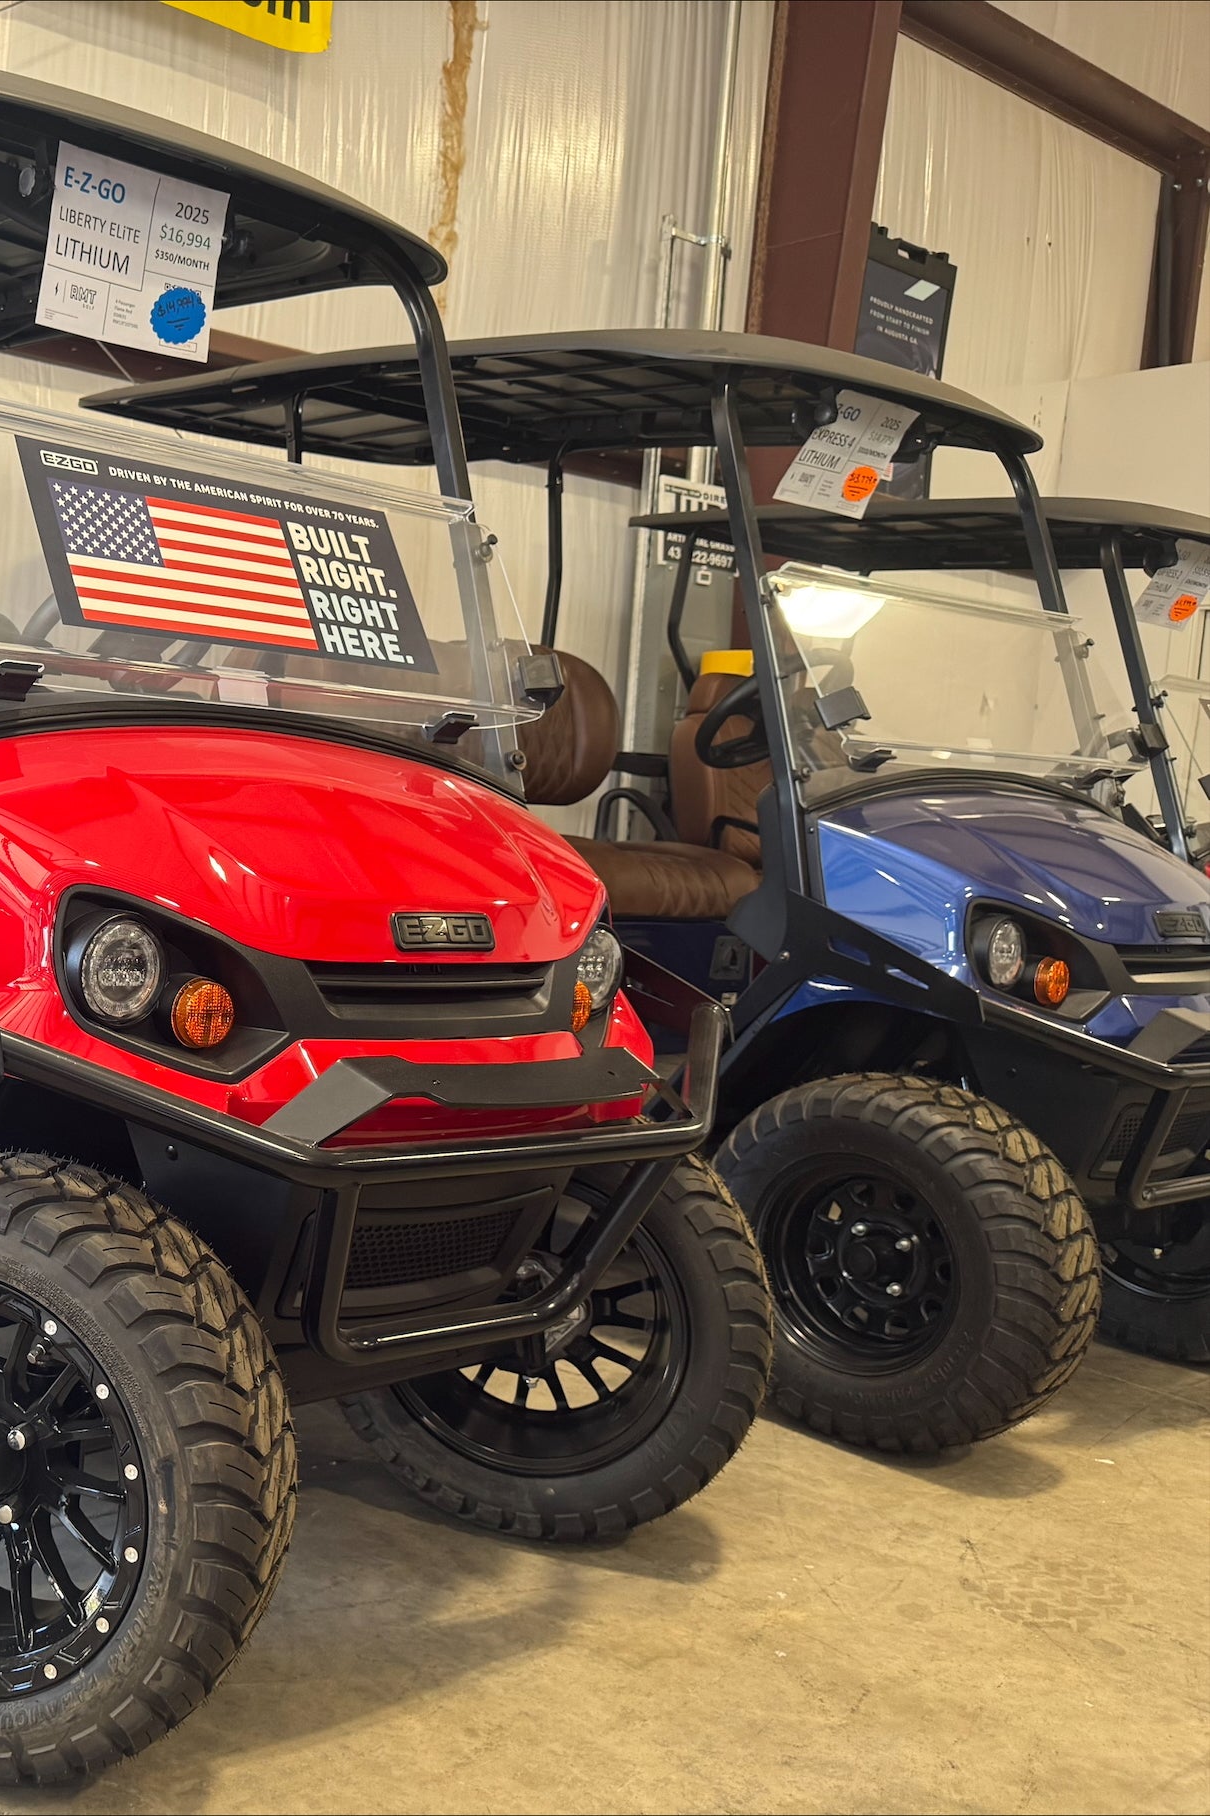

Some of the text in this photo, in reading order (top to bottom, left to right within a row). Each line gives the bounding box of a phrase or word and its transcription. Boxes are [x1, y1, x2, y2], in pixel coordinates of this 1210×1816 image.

[64, 166, 126, 204] E-Z-GO
[59, 206, 107, 233] LIBERTY
[175, 202, 210, 225] 2025
[159, 224, 211, 250] $16,994
[55, 234, 130, 275] LITHIUM
[155, 249, 210, 271] $350/MONTH
[870, 308, 930, 336] FROM START TO FINISH
[884, 328, 908, 342] AUGUSTA
[838, 403, 861, 421] Z-GO
[880, 416, 901, 431] 2025
[798, 448, 841, 469] LITHIUM
[42, 451, 379, 529] EZGO DRIVEN BY THE AMERICAN SPIRIT FOR OVER 70 YEARS.
[286, 521, 371, 564] BUILT
[297, 553, 398, 599] RIGHT.
[308, 589, 399, 631] RIGHT
[319, 622, 415, 665] HERE.
[395, 915, 491, 945] EZGO
